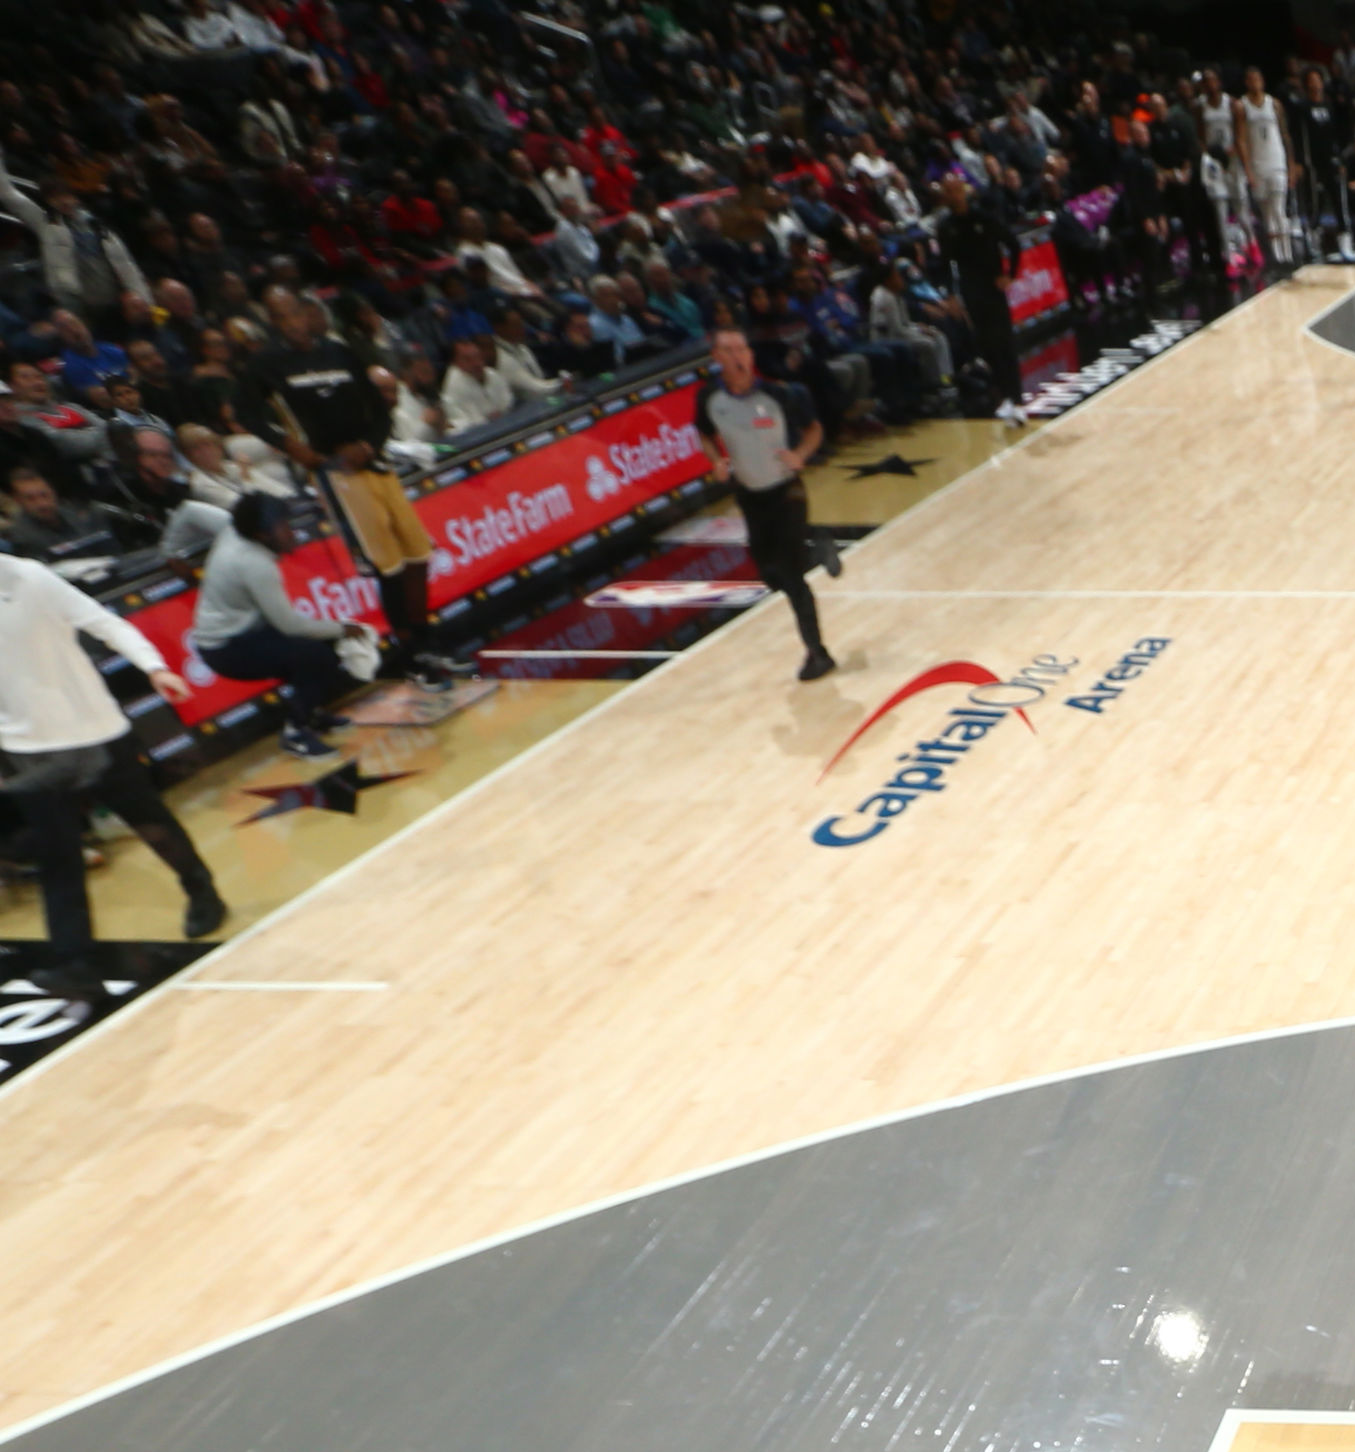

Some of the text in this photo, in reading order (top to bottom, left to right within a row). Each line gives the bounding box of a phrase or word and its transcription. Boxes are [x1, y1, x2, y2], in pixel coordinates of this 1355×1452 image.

[1063, 637, 1173, 715] Arena
[811, 653, 1080, 848] Capital One
